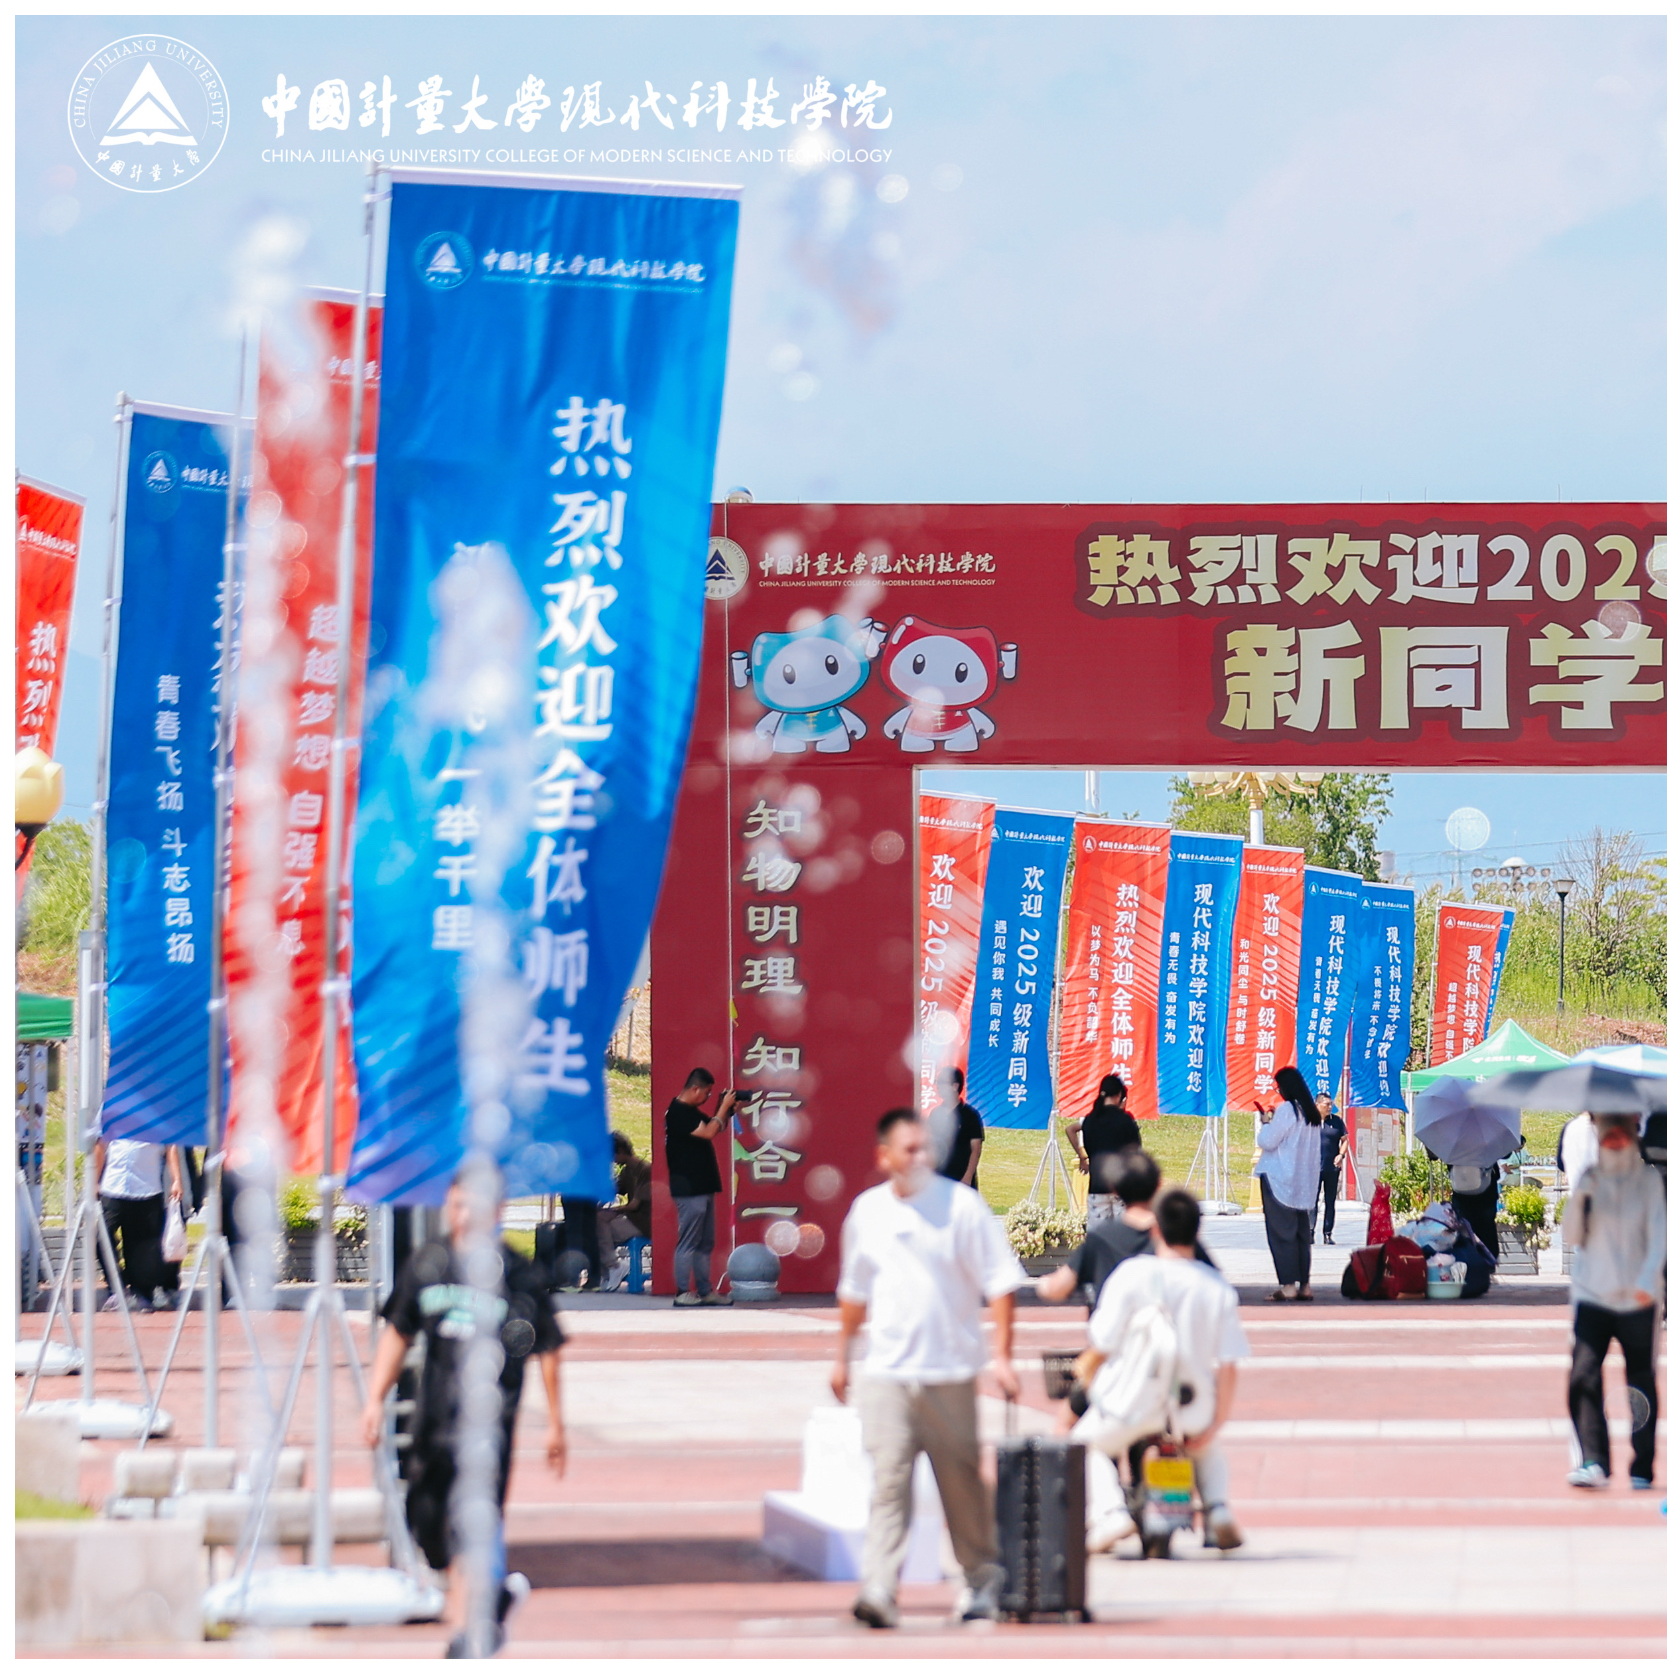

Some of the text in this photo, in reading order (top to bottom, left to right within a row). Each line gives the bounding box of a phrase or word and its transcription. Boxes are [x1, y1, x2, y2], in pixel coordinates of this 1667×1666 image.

[512, 396, 633, 1097] 热烈欢迎全体师生
[1221, 618, 1665, 733] 新同学
[154, 673, 195, 965] 青春飞扬 斗志昂扬
[927, 853, 957, 910] 欢迎
[740, 798, 804, 1219] 知物明理 知行合一
[987, 919, 1008, 1048] 遇见你我 共同成长
[1006, 865, 1046, 1108] 欢迎 2025 级新同学
[1109, 883, 1140, 1087] 热烈欢迎全体师生
[1186, 883, 1215, 1093] 现代科技学院欢迎您
[1253, 893, 1281, 1095] 欢迎 2025 级新同学
